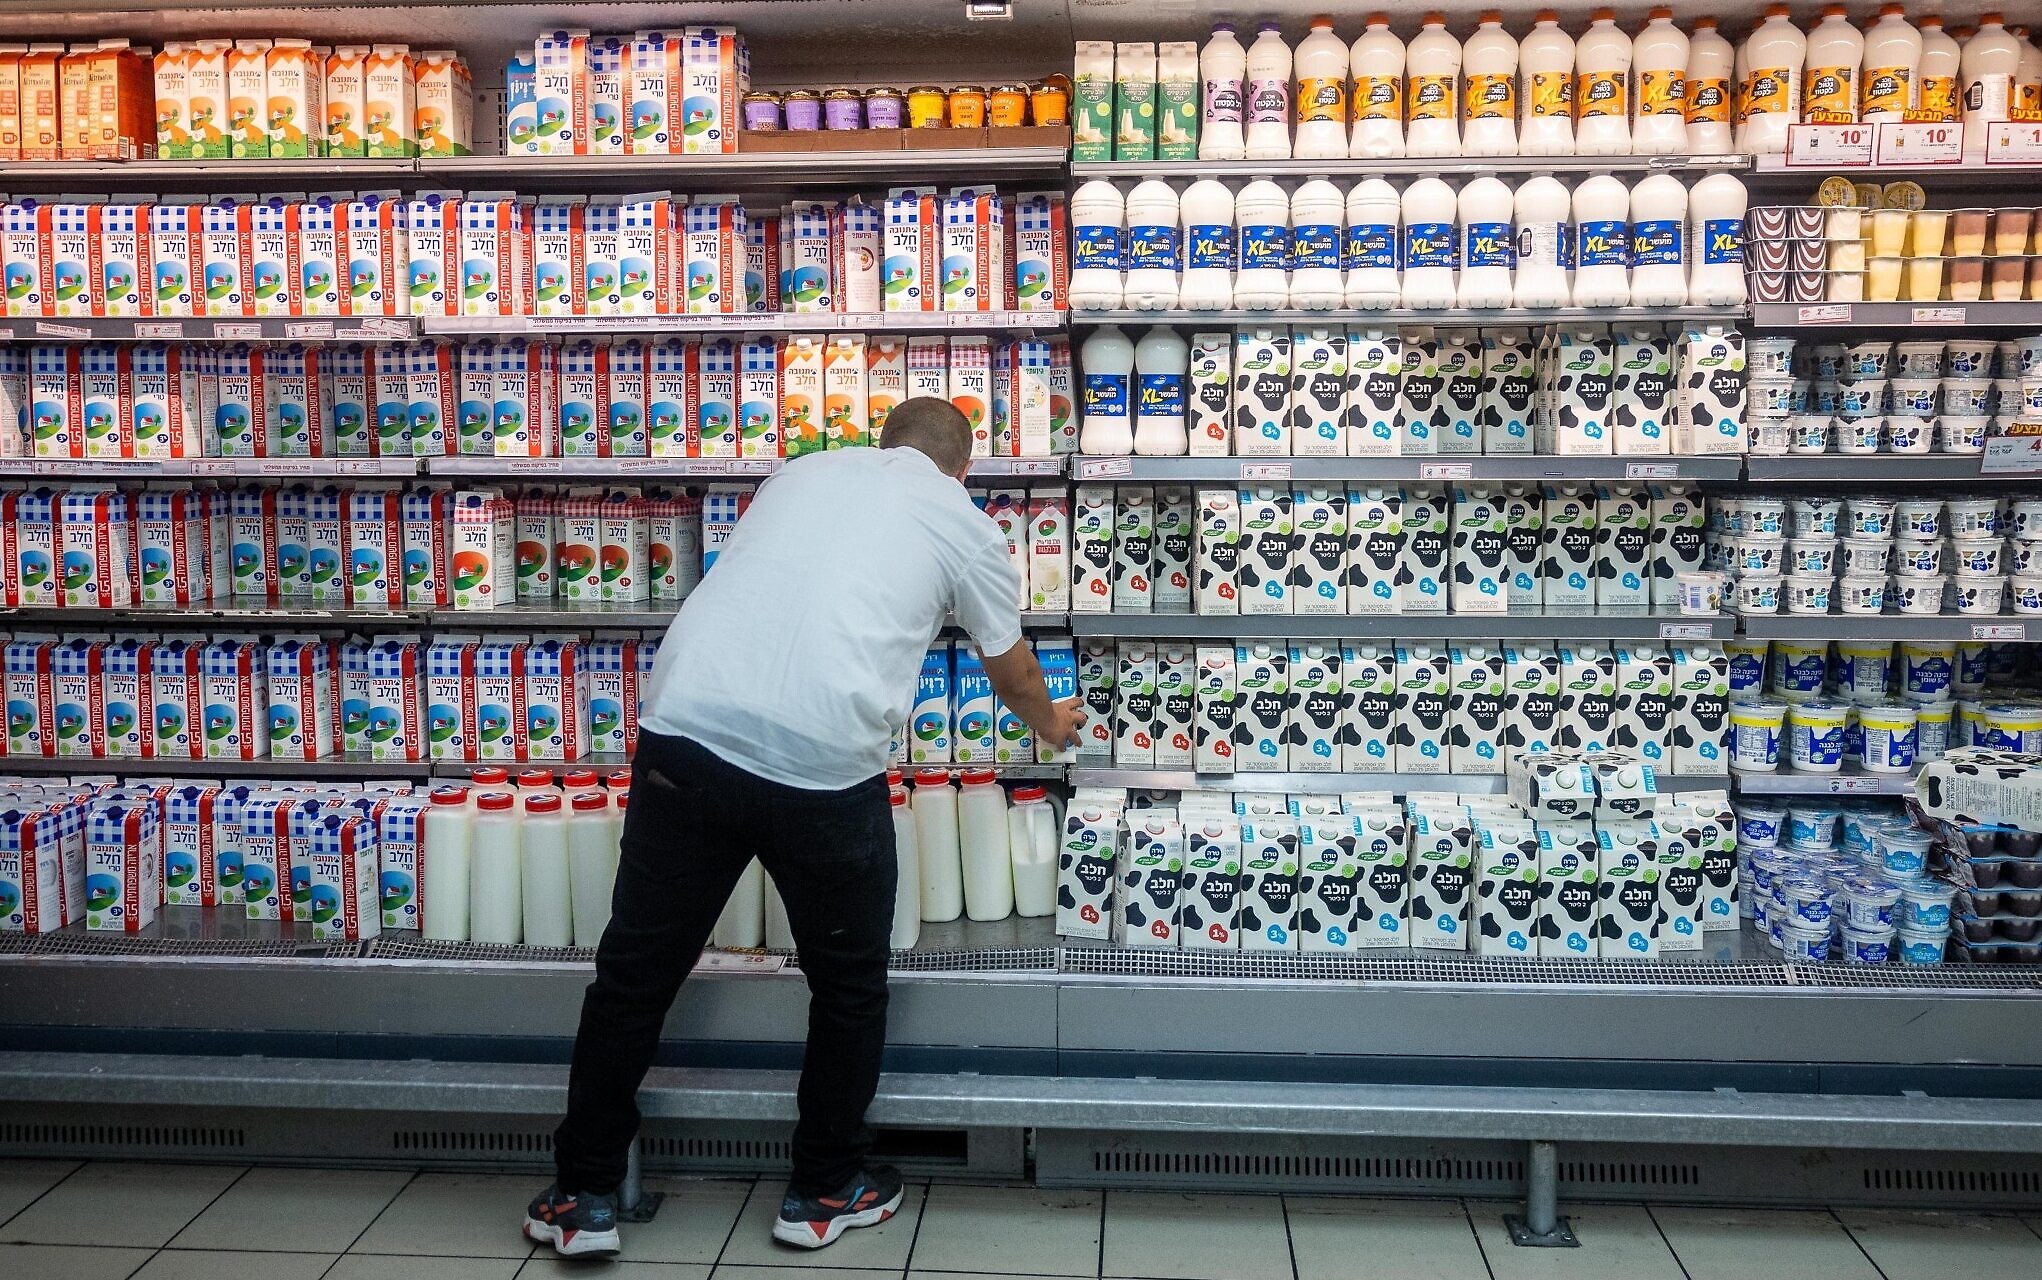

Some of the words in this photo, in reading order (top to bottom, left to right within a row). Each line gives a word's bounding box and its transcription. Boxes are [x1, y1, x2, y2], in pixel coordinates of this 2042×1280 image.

[545, 76, 568, 87] חלב
[693, 75, 716, 86] חלב
[1541, 89, 1563, 104] XL
[1904, 110, 1943, 121] מבצע!
[2013, 109, 2042, 120] בצע!
[1841, 131, 1861, 144] 10
[1927, 130, 1945, 143] 10
[894, 235, 916, 246] חלב
[1586, 237, 1608, 251] XL
[12, 243, 34, 252] חלב
[261, 241, 283, 252] חלב
[695, 242, 716, 252] חלב
[1077, 240, 1097, 255] XL
[1295, 240, 1314, 254] XL
[796, 376, 816, 385] חלב
[962, 377, 982, 387] חלב
[40, 383, 63, 392] חלב
[502, 381, 524, 391] חלב
[660, 382, 682, 392] חלב
[1259, 381, 1283, 392] חלב
[1581, 382, 1606, 392] חלב
[1143, 389, 1160, 403] XL
[1204, 388, 1223, 398] חלב
[1210, 427, 1221, 435] 1%
[1266, 427, 1277, 435] 3%
[1587, 425, 1599, 434] 3%
[70, 533, 92, 542] חלב
[466, 532, 486, 542] חלב
[1566, 535, 1590, 545] חלב
[1087, 544, 1108, 554] חלב
[1262, 542, 1286, 550] חלב
[1093, 583, 1105, 592] 1%
[114, 682, 134, 693] חלב
[436, 686, 458, 695] חלב
[1131, 699, 1150, 708] חלב
[1257, 700, 1281, 709] חלב
[1697, 702, 1721, 711] חלב
[1262, 744, 1274, 752] 3%
[97, 853, 120, 865] חלב
[1706, 858, 1730, 868] חלב
[317, 863, 338, 875] חלב
[1081, 864, 1106, 876] חלב
[1206, 882, 1232, 893] חלב
[1564, 890, 1590, 900] חלב
[1212, 929, 1225, 938] 1%
[1571, 939, 1583, 947] 3%
